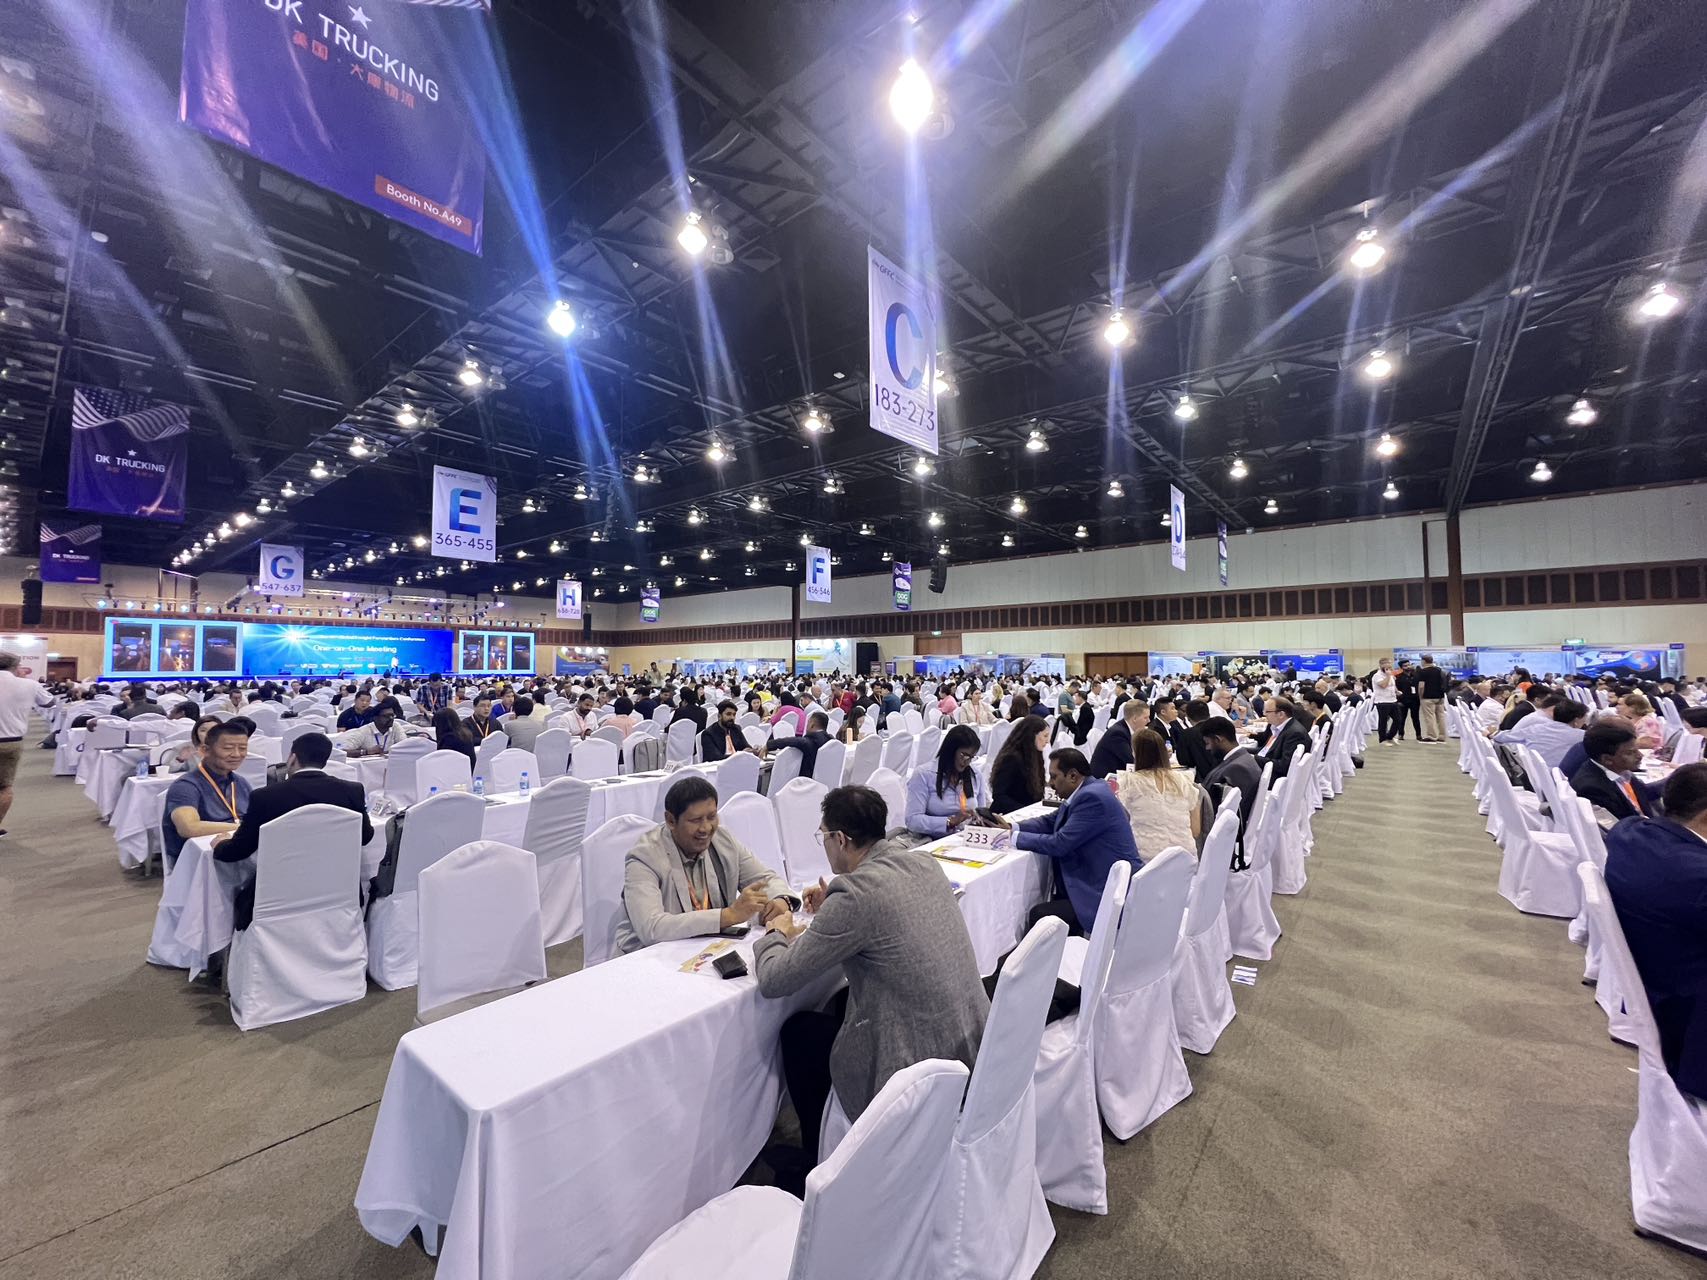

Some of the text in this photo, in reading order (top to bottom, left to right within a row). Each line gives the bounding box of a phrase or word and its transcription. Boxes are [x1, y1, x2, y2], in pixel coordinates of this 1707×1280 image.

[318, 12, 439, 101] TRUCKING
[386, 183, 462, 226] Booth No.A49
[885, 302, 923, 390] C
[875, 383, 935, 431] 183-273
[95, 453, 111, 464] DK
[115, 456, 165, 473] TRUCKING
[449, 487, 482, 534] E
[435, 532, 494, 550] 365-455
[270, 555, 295, 580] G
[812, 556, 825, 584] F
[262, 582, 301, 592] 547-637
[563, 588, 575, 606] H
[366, 645, 397, 654] Meeting
[966, 832, 988, 844] 233
